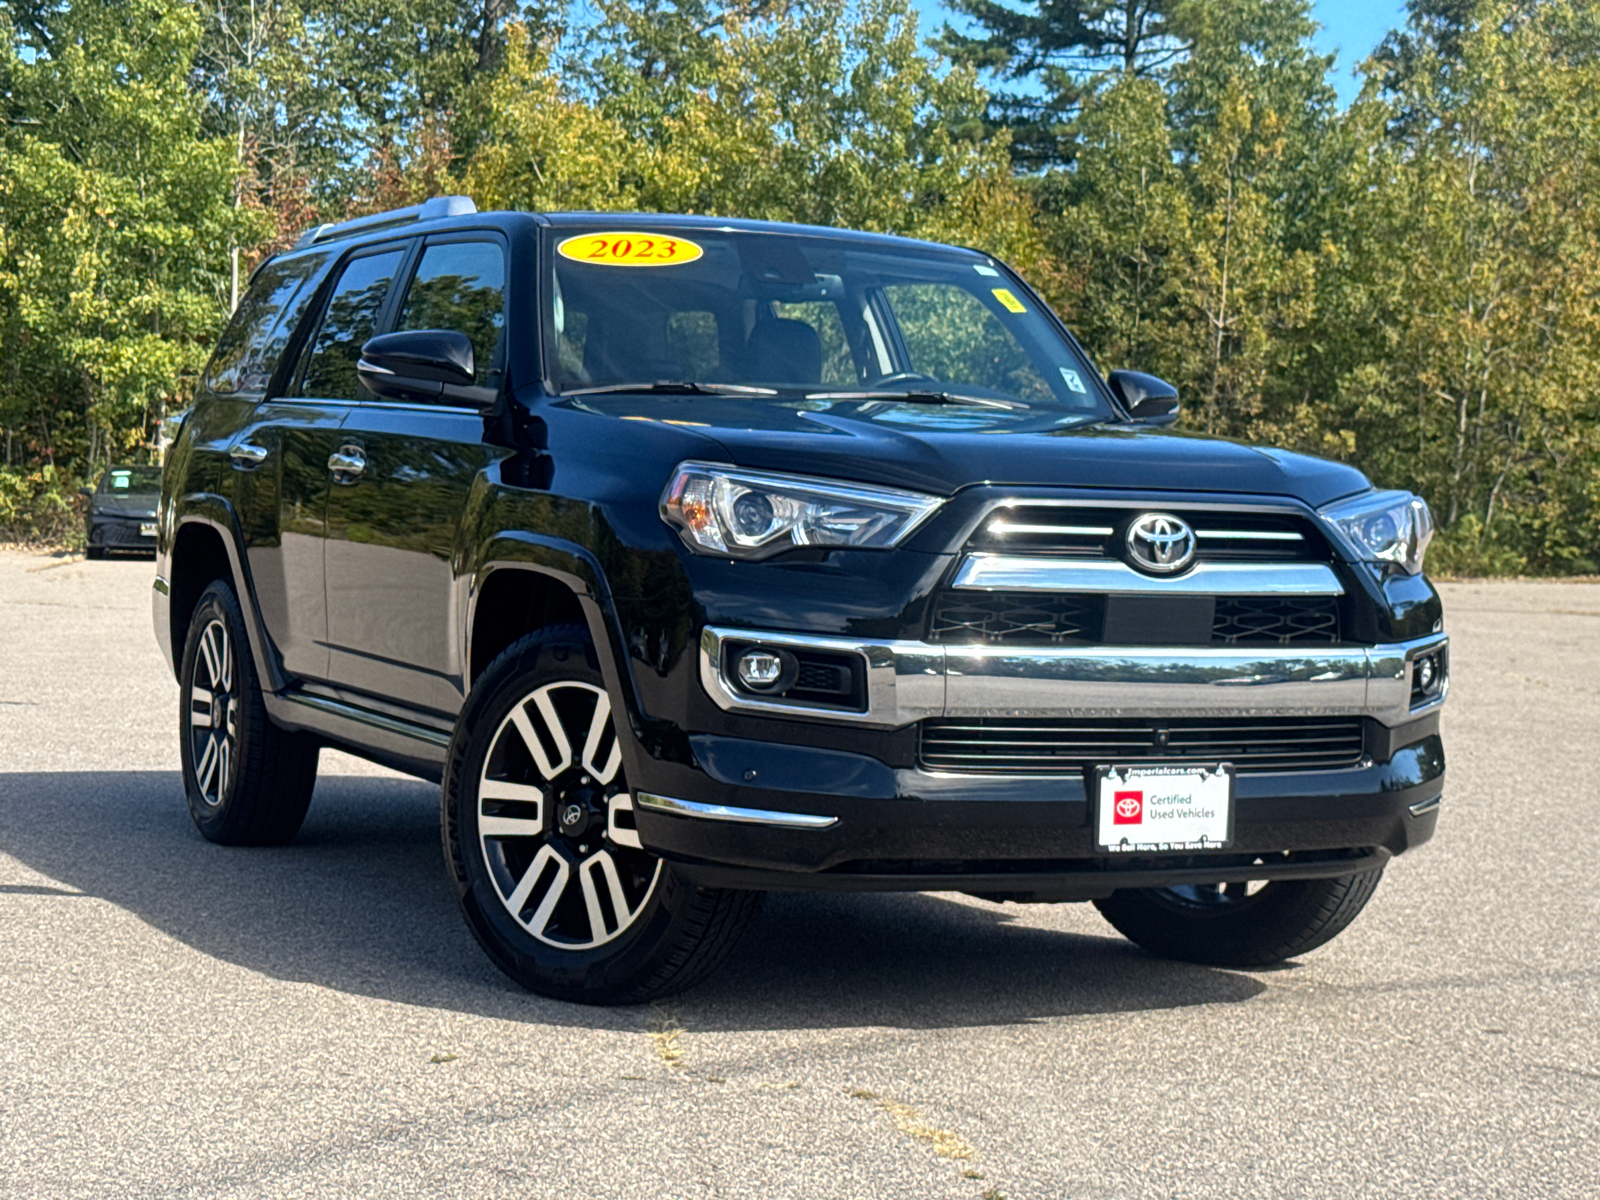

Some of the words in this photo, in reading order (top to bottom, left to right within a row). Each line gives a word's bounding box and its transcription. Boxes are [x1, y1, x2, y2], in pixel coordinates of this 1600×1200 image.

[587, 239, 677, 259] 2023
[1150, 793, 1192, 805] Certified
[447, 740, 468, 882] GENERAL
[1150, 808, 1174, 819] Used
[1176, 807, 1215, 819] Vehicles
[1108, 844, 1120, 853] We
[1121, 843, 1135, 852] Sell
[1158, 842, 1168, 851] So
[1169, 841, 1184, 850] You
[1185, 841, 1202, 850] Save
[1203, 840, 1222, 849] More
